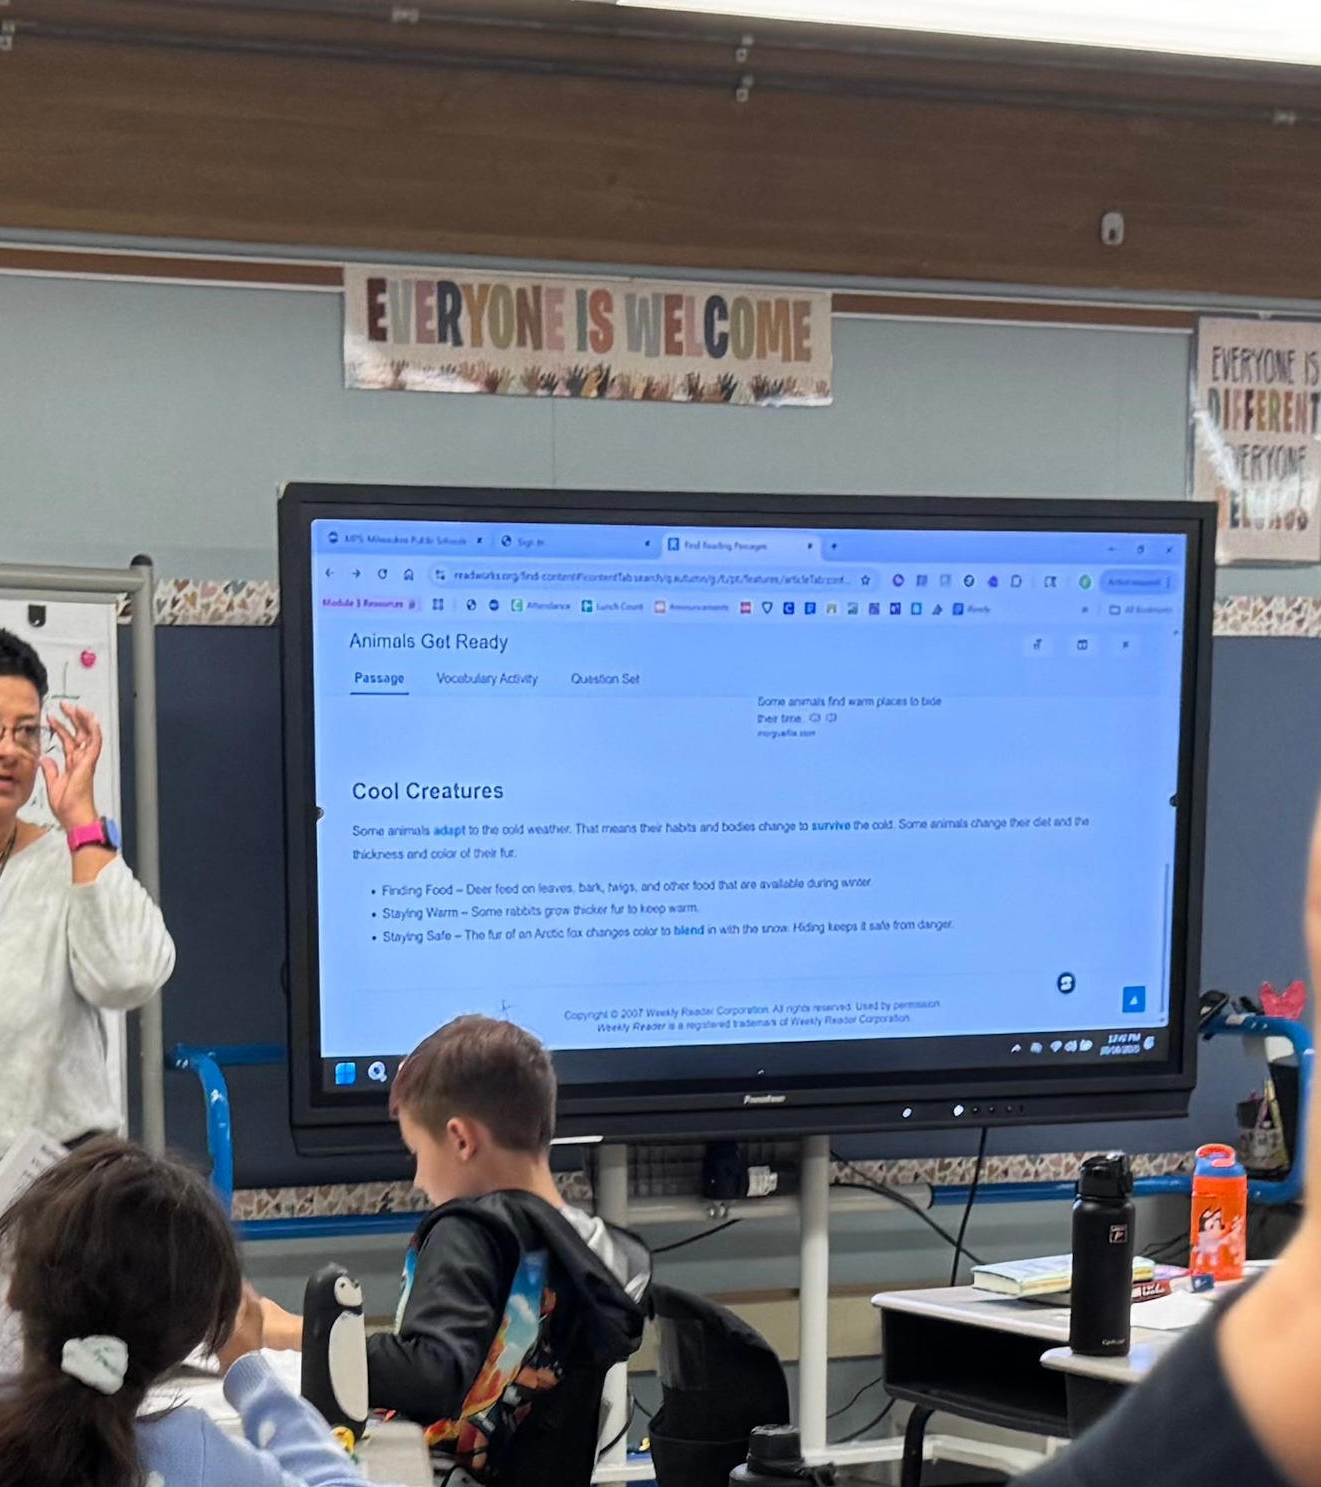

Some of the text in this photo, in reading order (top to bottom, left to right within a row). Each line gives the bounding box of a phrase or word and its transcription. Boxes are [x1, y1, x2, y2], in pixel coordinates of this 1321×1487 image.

[366, 276, 812, 363] EVERYONE IS WELCOME
[1211, 346, 1320, 386] EVERYONE IS
[1207, 388, 1321, 434] DIFFERENT
[1225, 444, 1307, 483] ERYONE
[349, 632, 509, 654] Animals Get Ready
[354, 672, 641, 687] Passage Vocabulary Activity Question Set
[757, 696, 785, 707] Some
[788, 696, 826, 707] animals
[828, 696, 846, 707] find
[352, 781, 504, 800] Cool Creatures
[352, 815, 1090, 839] Some animals adapt to the cold weather. That means their habits and bodies change to survive the Some animals change their diet and the
[352, 849, 404, 861] thickness
[406, 848, 428, 861] and
[430, 848, 457, 860] color
[459, 847, 471, 859] of
[473, 847, 497, 859] their
[381, 885, 423, 899] Finding
[425, 884, 453, 897] Food
[466, 884, 492, 896] Deer
[522, 884, 536, 895] on
[538, 882, 576, 895] leaves,
[578, 881, 606, 895] bark,
[641, 880, 661, 893] and
[663, 880, 690, 892] other
[692, 879, 715, 892] food
[718, 878, 738, 890] that
[740, 880, 757, 890] are
[759, 878, 805, 890] available
[807, 877, 839, 891] during
[382, 907, 424, 922] Staying
[426, 907, 459, 919] Warm
[471, 906, 503, 918] Some
[505, 905, 542, 918] rabbits
[544, 906, 570, 919] grow
[573, 904, 608, 917] thicker
[611, 904, 625, 916] fur
[640, 903, 666, 916] keep
[383, 931, 424, 945] Staying
[427, 930, 452, 942] Safe
[464, 929, 485, 942] The
[487, 928, 502, 941] fur
[519, 930, 533, 940] an
[534, 927, 565, 940] Arctic
[567, 927, 584, 939] fox
[586, 926, 631, 940] changes
[633, 925, 659, 938] color
[673, 924, 705, 936] blend
[719, 923, 740, 935] with
[742, 923, 759, 935] the
[792, 922, 825, 936] Hiding
[828, 921, 858, 935] keeps
[869, 920, 890, 931] safe
[892, 919, 915, 931] from
[564, 1009, 609, 1022] Copyright
[620, 1008, 644, 1020] 2007
[646, 1006, 679, 1020] Weekly
[681, 1006, 714, 1017] Reader
[785, 1003, 811, 1016] rights
[855, 1000, 878, 1012] Used
[597, 1014, 858, 1034] Weekly Reader registered trademark Weekly Reader
